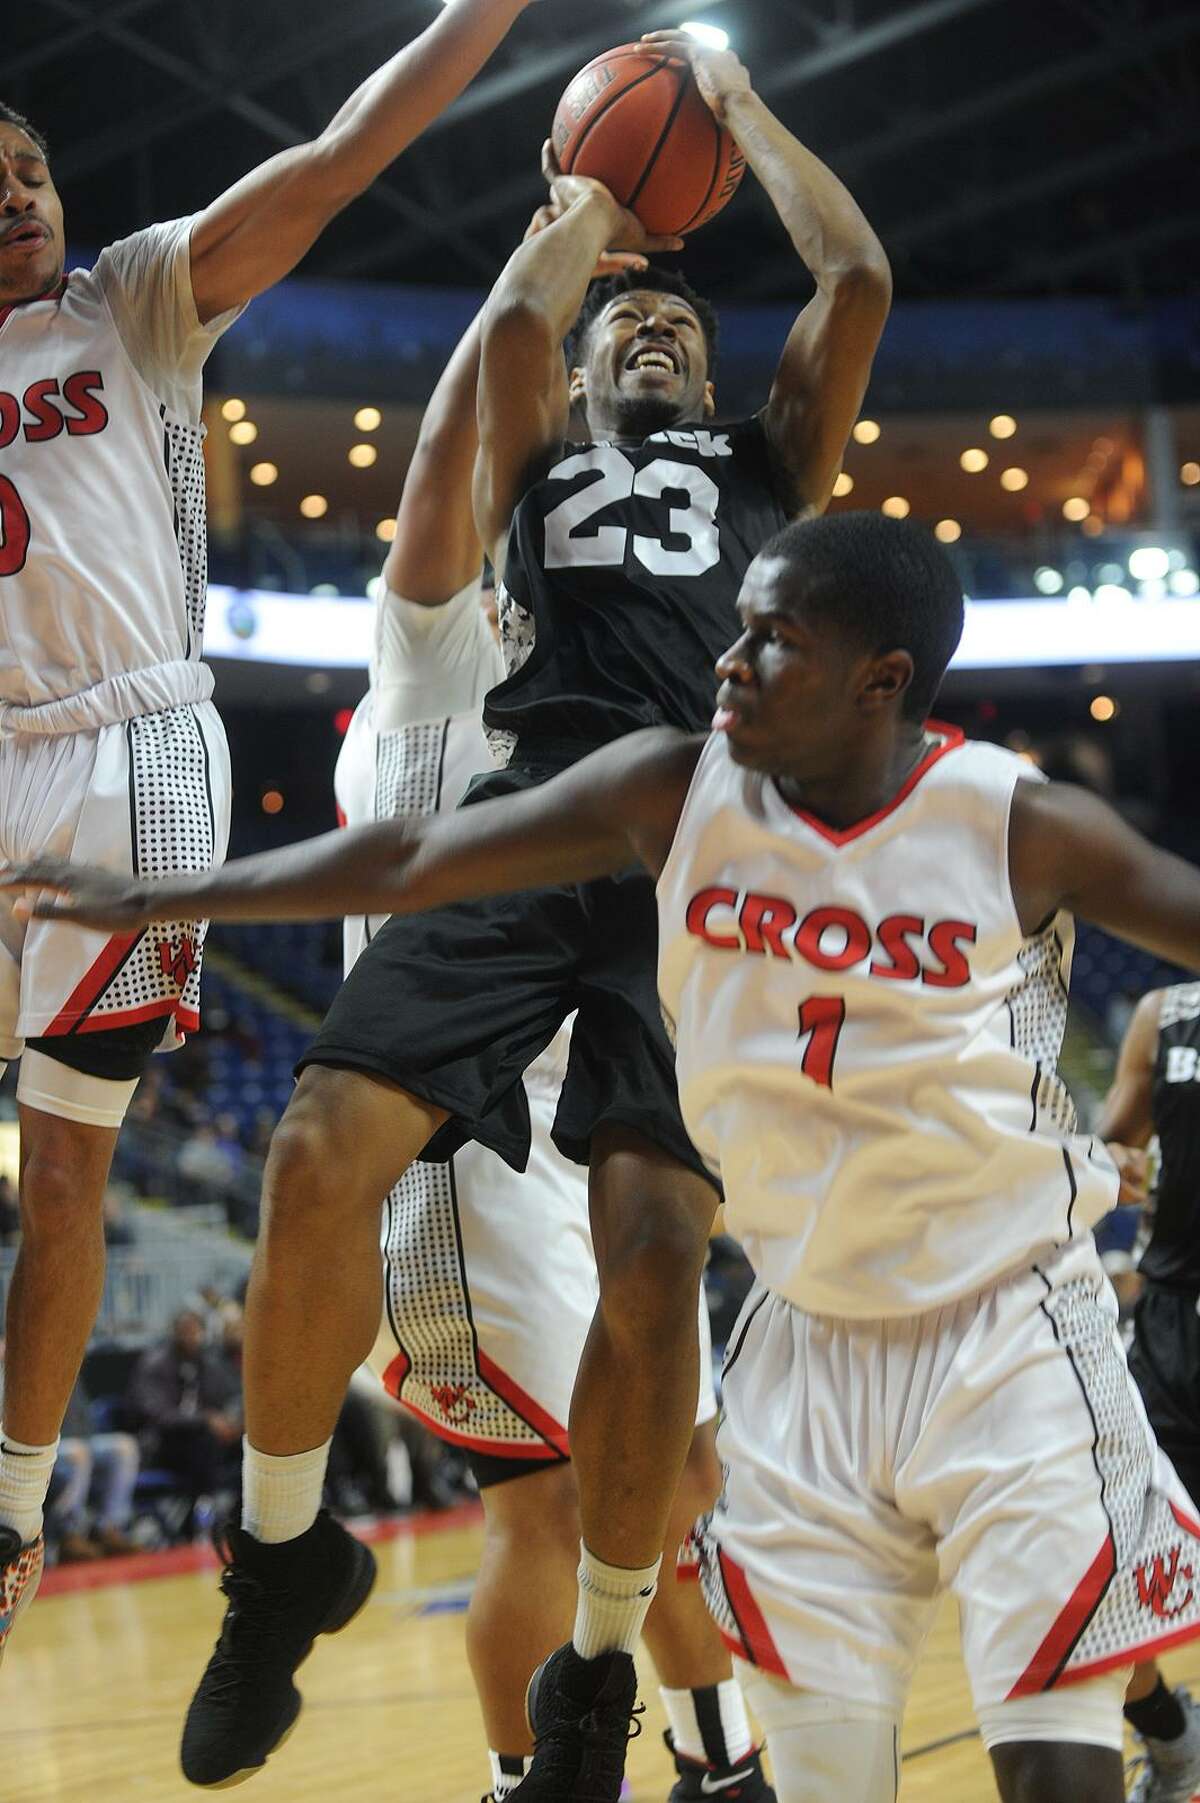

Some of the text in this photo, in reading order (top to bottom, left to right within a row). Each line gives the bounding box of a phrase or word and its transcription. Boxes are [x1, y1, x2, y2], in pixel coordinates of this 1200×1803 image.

[544, 448, 720, 576] 23
[686, 887, 976, 988] CROSS
[798, 995, 845, 1092] 1
